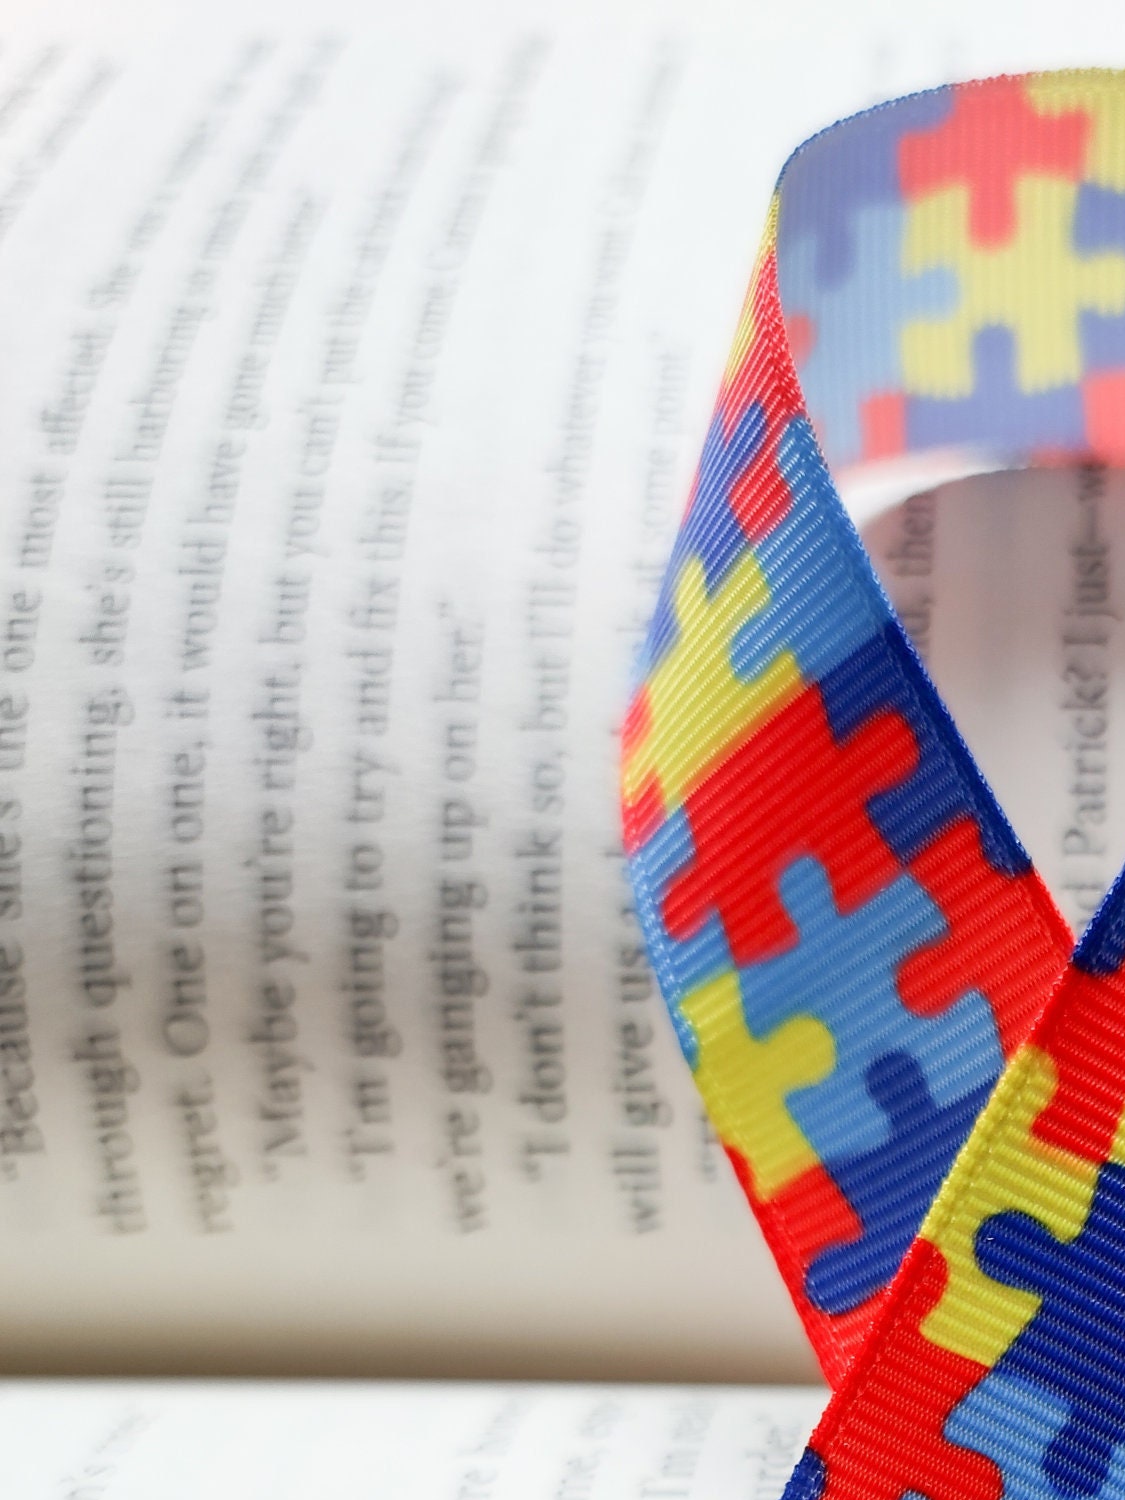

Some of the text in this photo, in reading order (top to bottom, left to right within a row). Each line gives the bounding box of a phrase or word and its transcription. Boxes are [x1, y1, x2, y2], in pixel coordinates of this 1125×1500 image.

[164, 864, 204, 928] on
[344, 842, 384, 892] to
[512, 830, 565, 974] think
[161, 944, 208, 1058] One
[343, 906, 402, 1059] going
